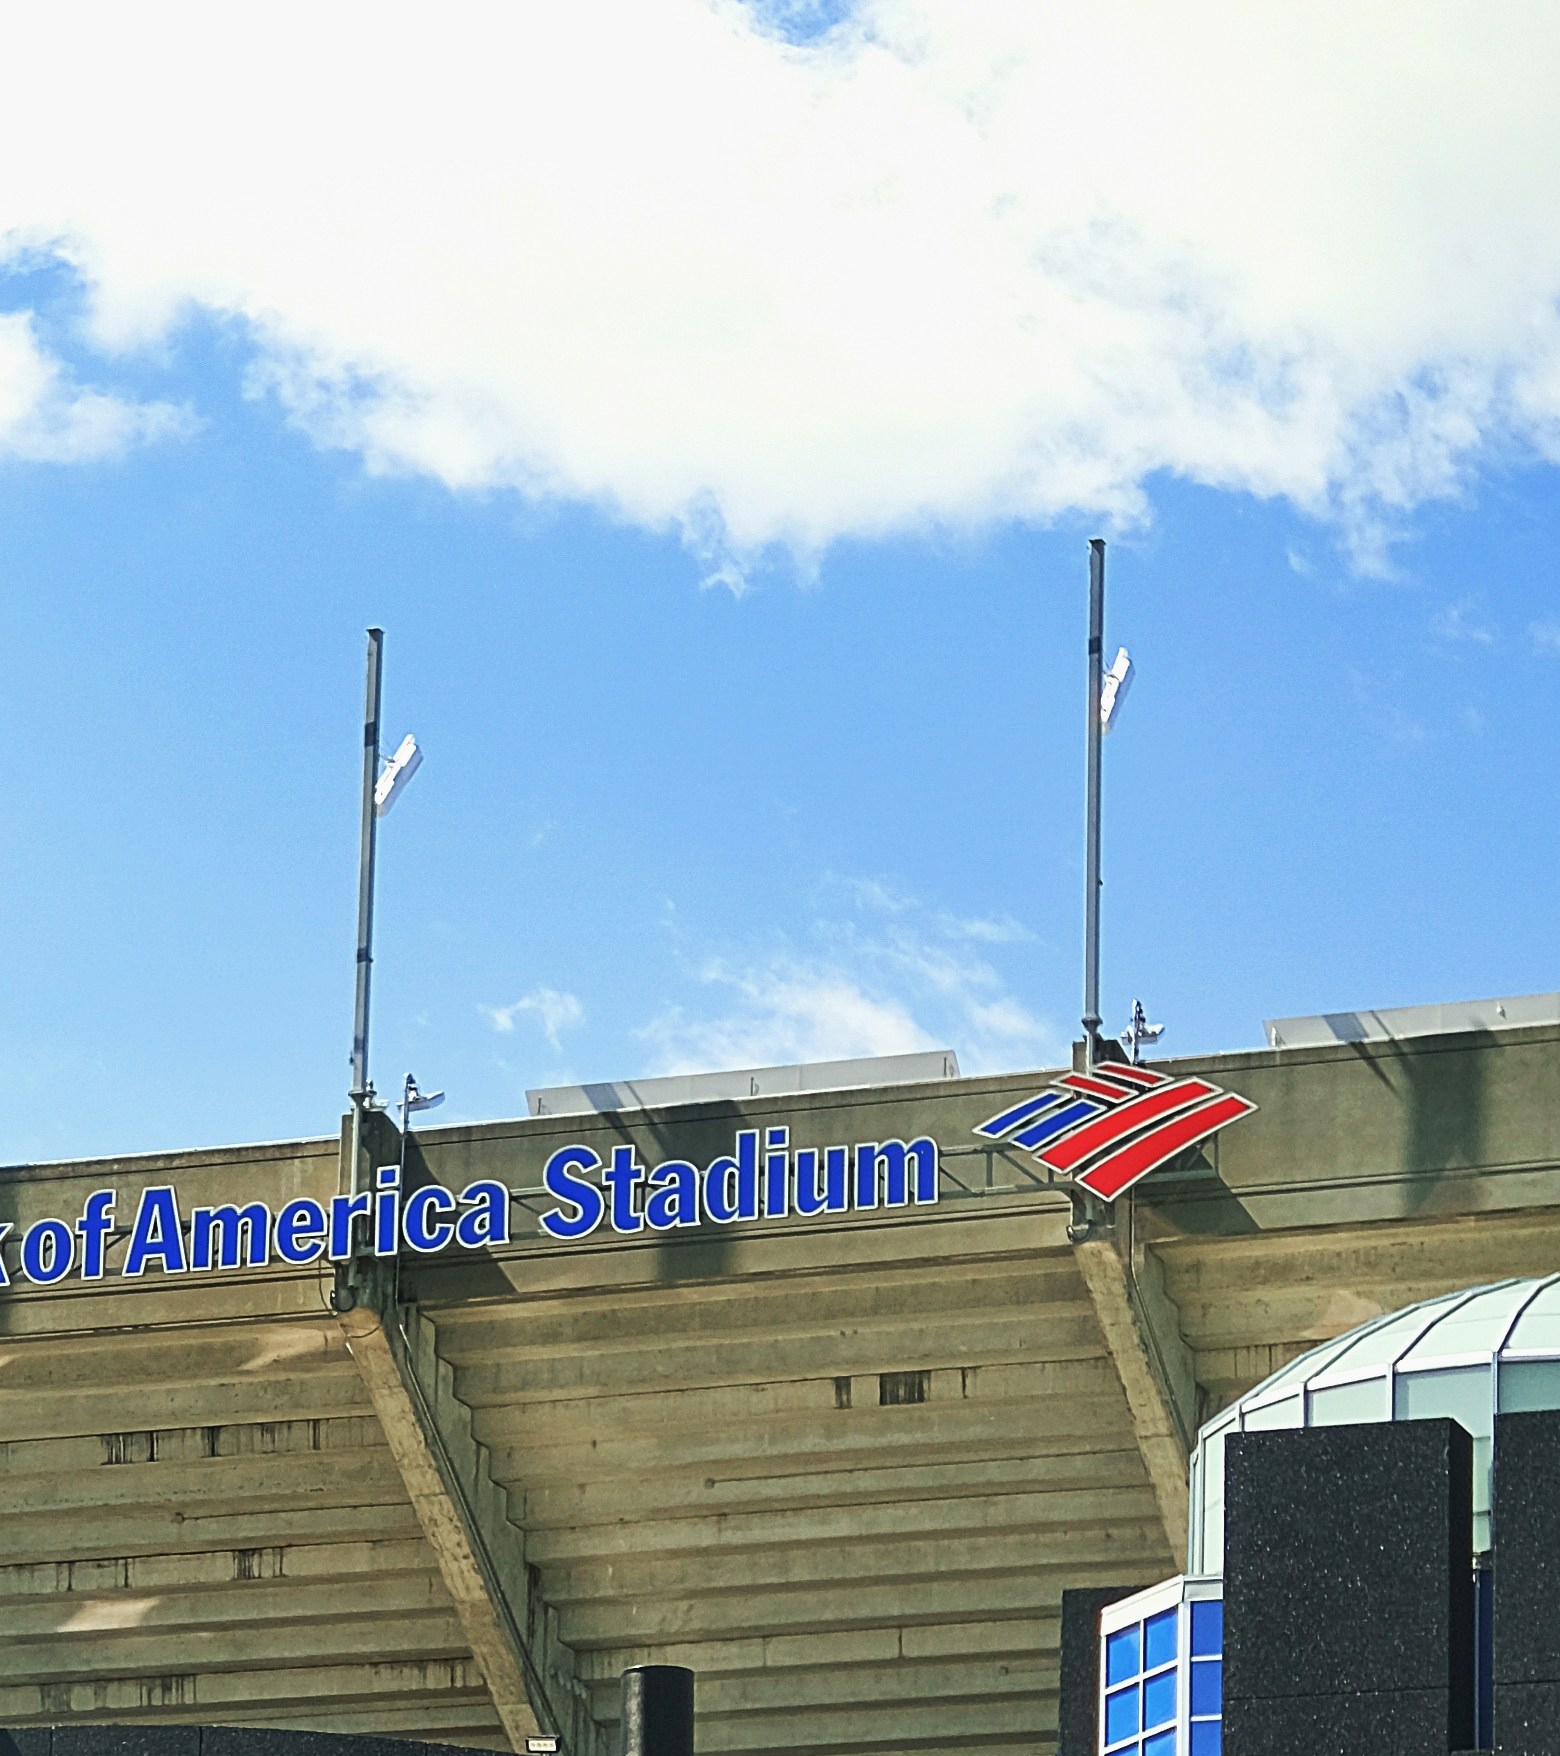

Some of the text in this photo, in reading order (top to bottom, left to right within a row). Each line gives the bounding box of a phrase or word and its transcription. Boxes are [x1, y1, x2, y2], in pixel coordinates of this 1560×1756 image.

[21, 1188, 117, 1286] of
[121, 1164, 510, 1277] America
[539, 1125, 940, 1239] Stadium
